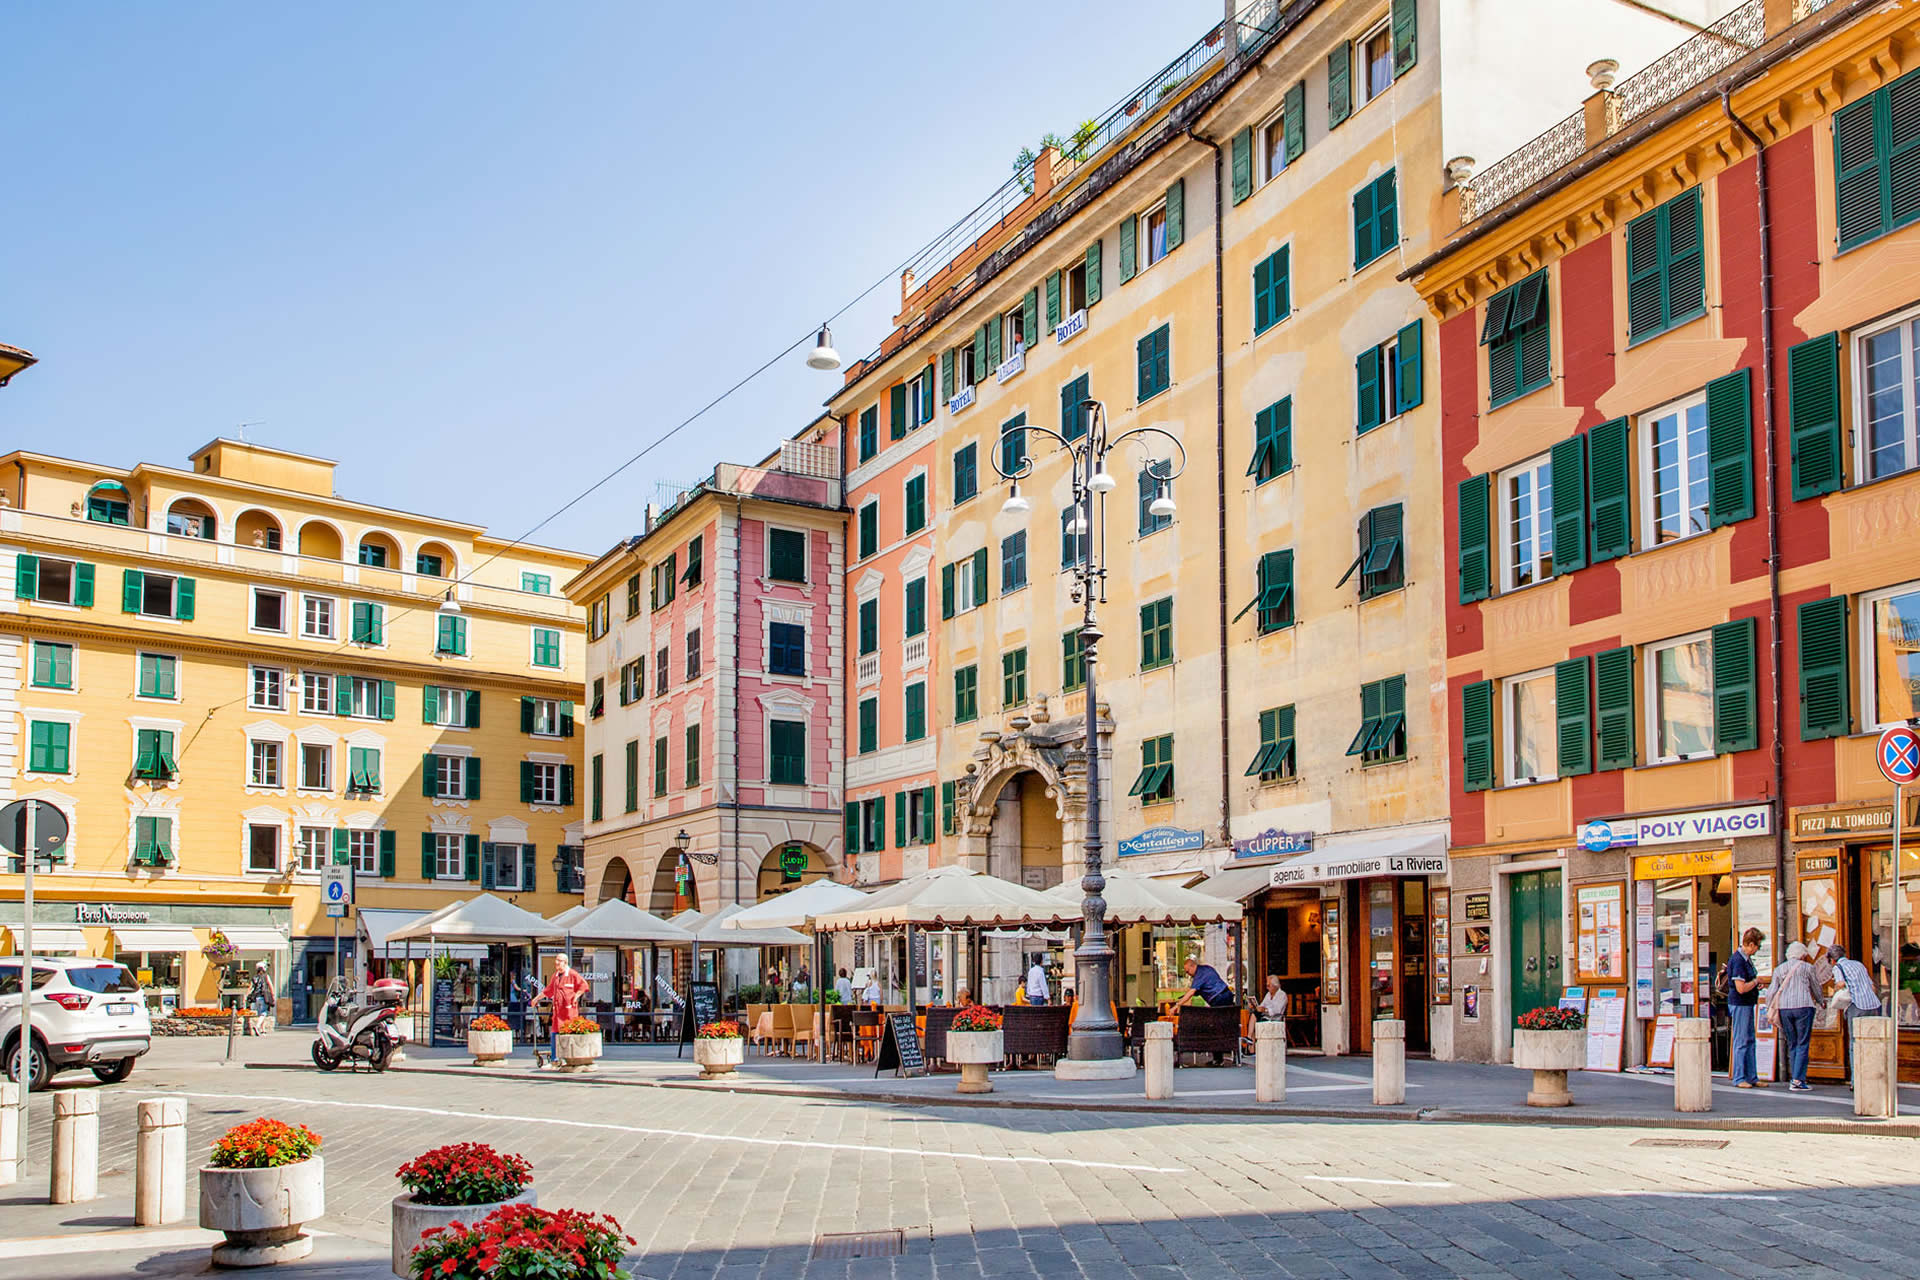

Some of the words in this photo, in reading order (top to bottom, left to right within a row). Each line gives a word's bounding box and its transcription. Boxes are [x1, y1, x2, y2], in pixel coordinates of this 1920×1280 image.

[1057, 314, 1083, 342] HOTEL
[950, 389, 972, 414] HOTEL
[1640, 820, 1687, 839] POLY
[1692, 812, 1766, 834] VIAGGI
[1802, 817, 1826, 831] PIZZI
[1830, 815, 1842, 829] AL
[1845, 811, 1892, 827] TOMBOLO
[1120, 835, 1200, 851] Montallegro
[1248, 836, 1294, 853] CLIPPER
[1273, 867, 1306, 885] agenzia
[1327, 859, 1381, 877] immobiliare
[1390, 857, 1403, 870] La
[1407, 857, 1443, 870] Riviera
[1805, 858, 1832, 869] CENTRI
[625, 1000, 642, 1009] BAR
